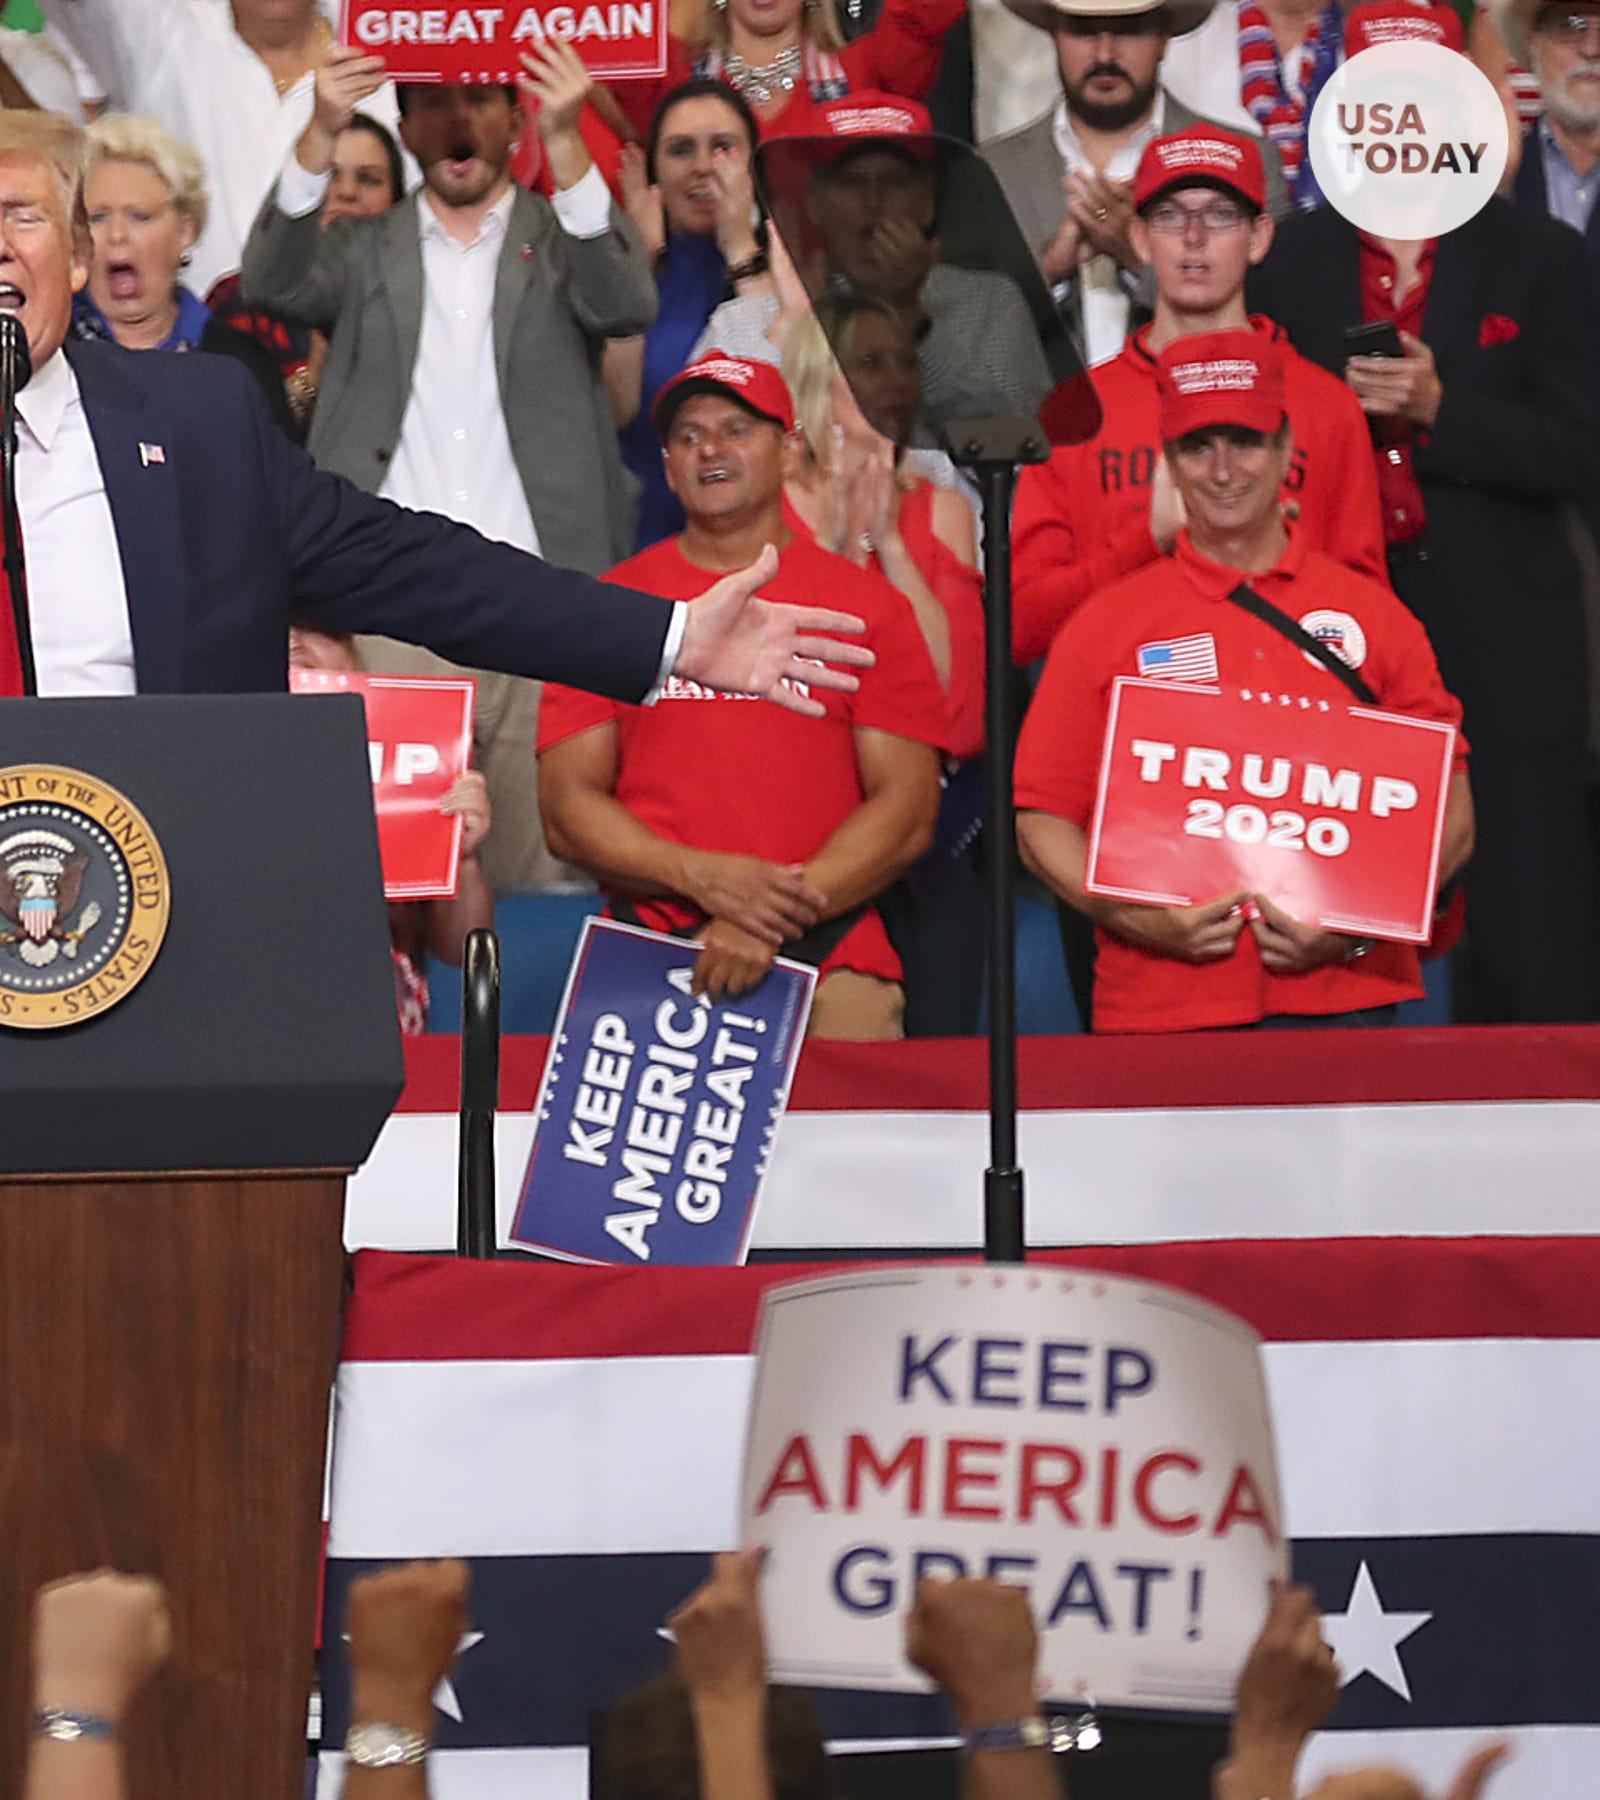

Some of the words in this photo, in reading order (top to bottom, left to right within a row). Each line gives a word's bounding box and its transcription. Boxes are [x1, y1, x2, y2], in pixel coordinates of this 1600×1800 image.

[355, 9, 504, 45] GREAT
[512, 2, 654, 43] AGAIN
[35, 777, 58, 794] OF
[65, 783, 97, 808] THE
[1131, 739, 1419, 818] TRUMP
[104, 804, 160, 910] UNITED
[1184, 797, 1351, 858] 2020
[63, 934, 150, 1015] STATES
[563, 1012, 637, 1167] KEEP
[674, 1010, 768, 1224] GREAT!
[897, 1333, 1157, 1416] KEEP
[755, 1433, 1282, 1548] AMERICA
